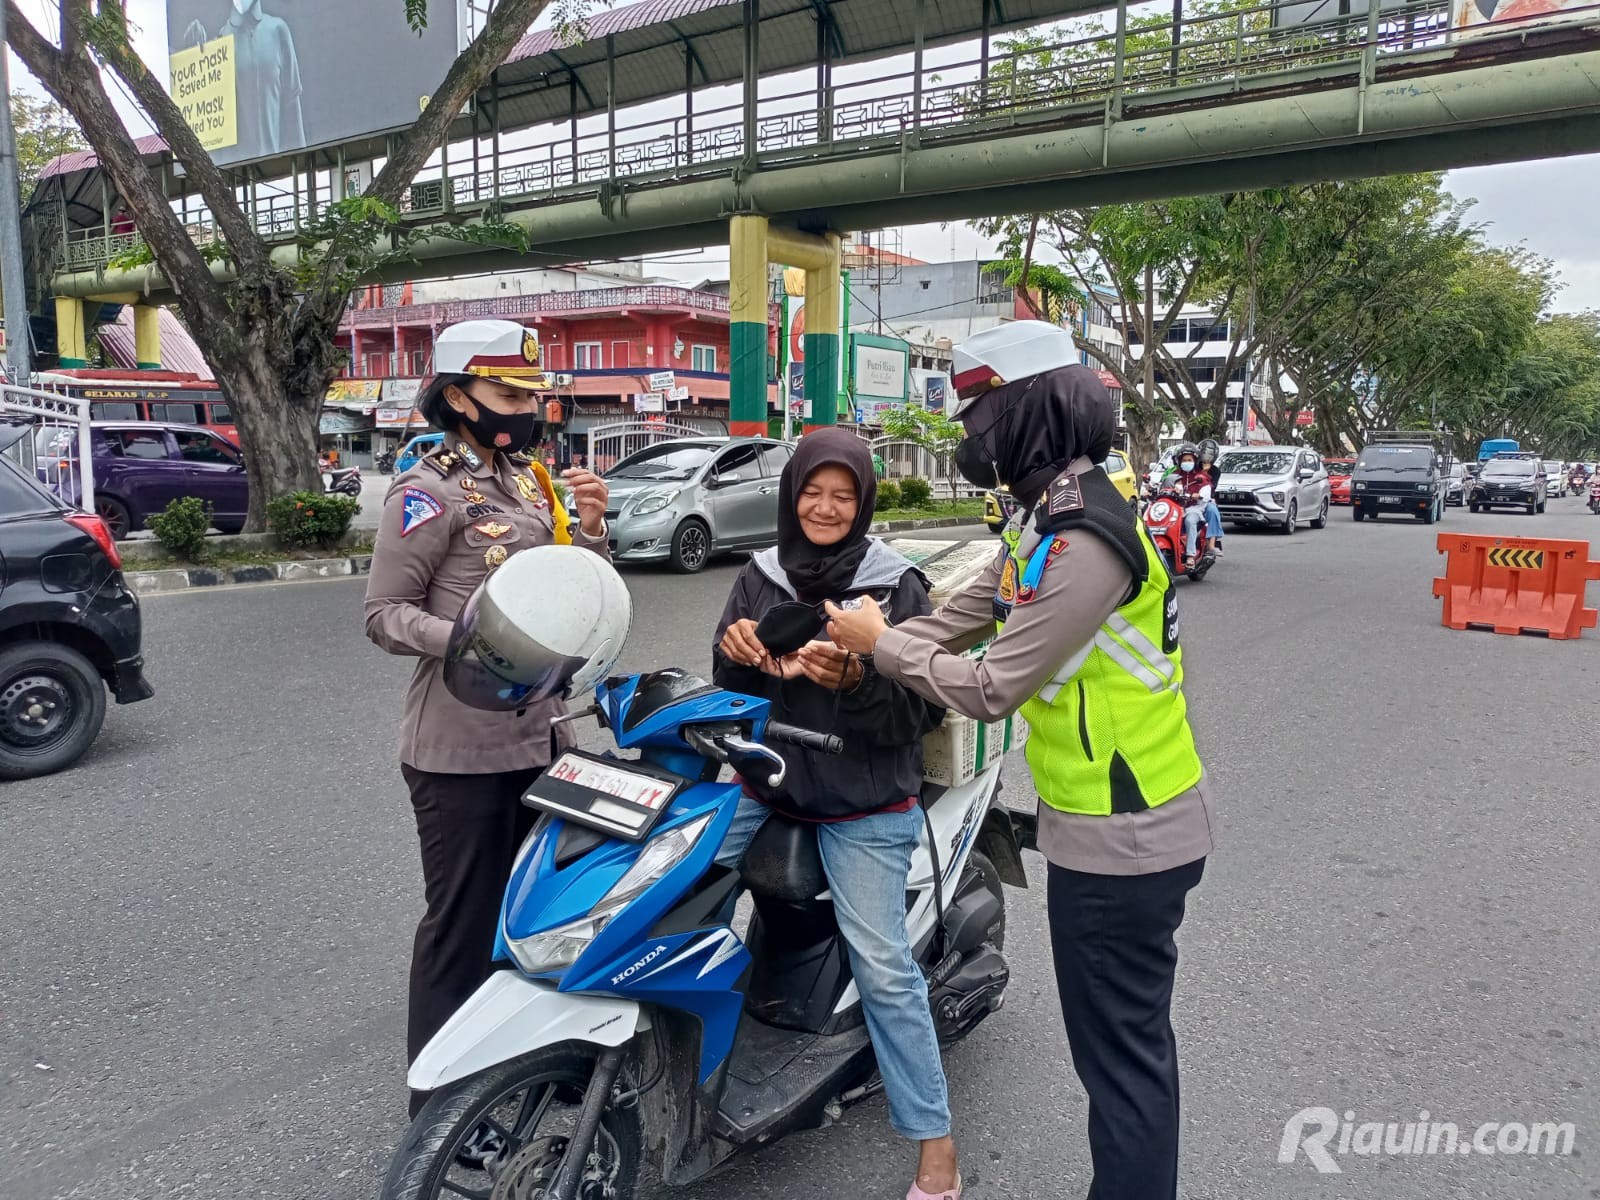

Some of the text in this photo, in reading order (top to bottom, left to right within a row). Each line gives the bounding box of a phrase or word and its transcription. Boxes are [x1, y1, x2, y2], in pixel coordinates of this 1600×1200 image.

[170, 62, 197, 86] YOUR
[84, 390, 138, 398] SELARAS
[1051, 540, 1061, 551] A
[611, 945, 667, 985] HONDA
